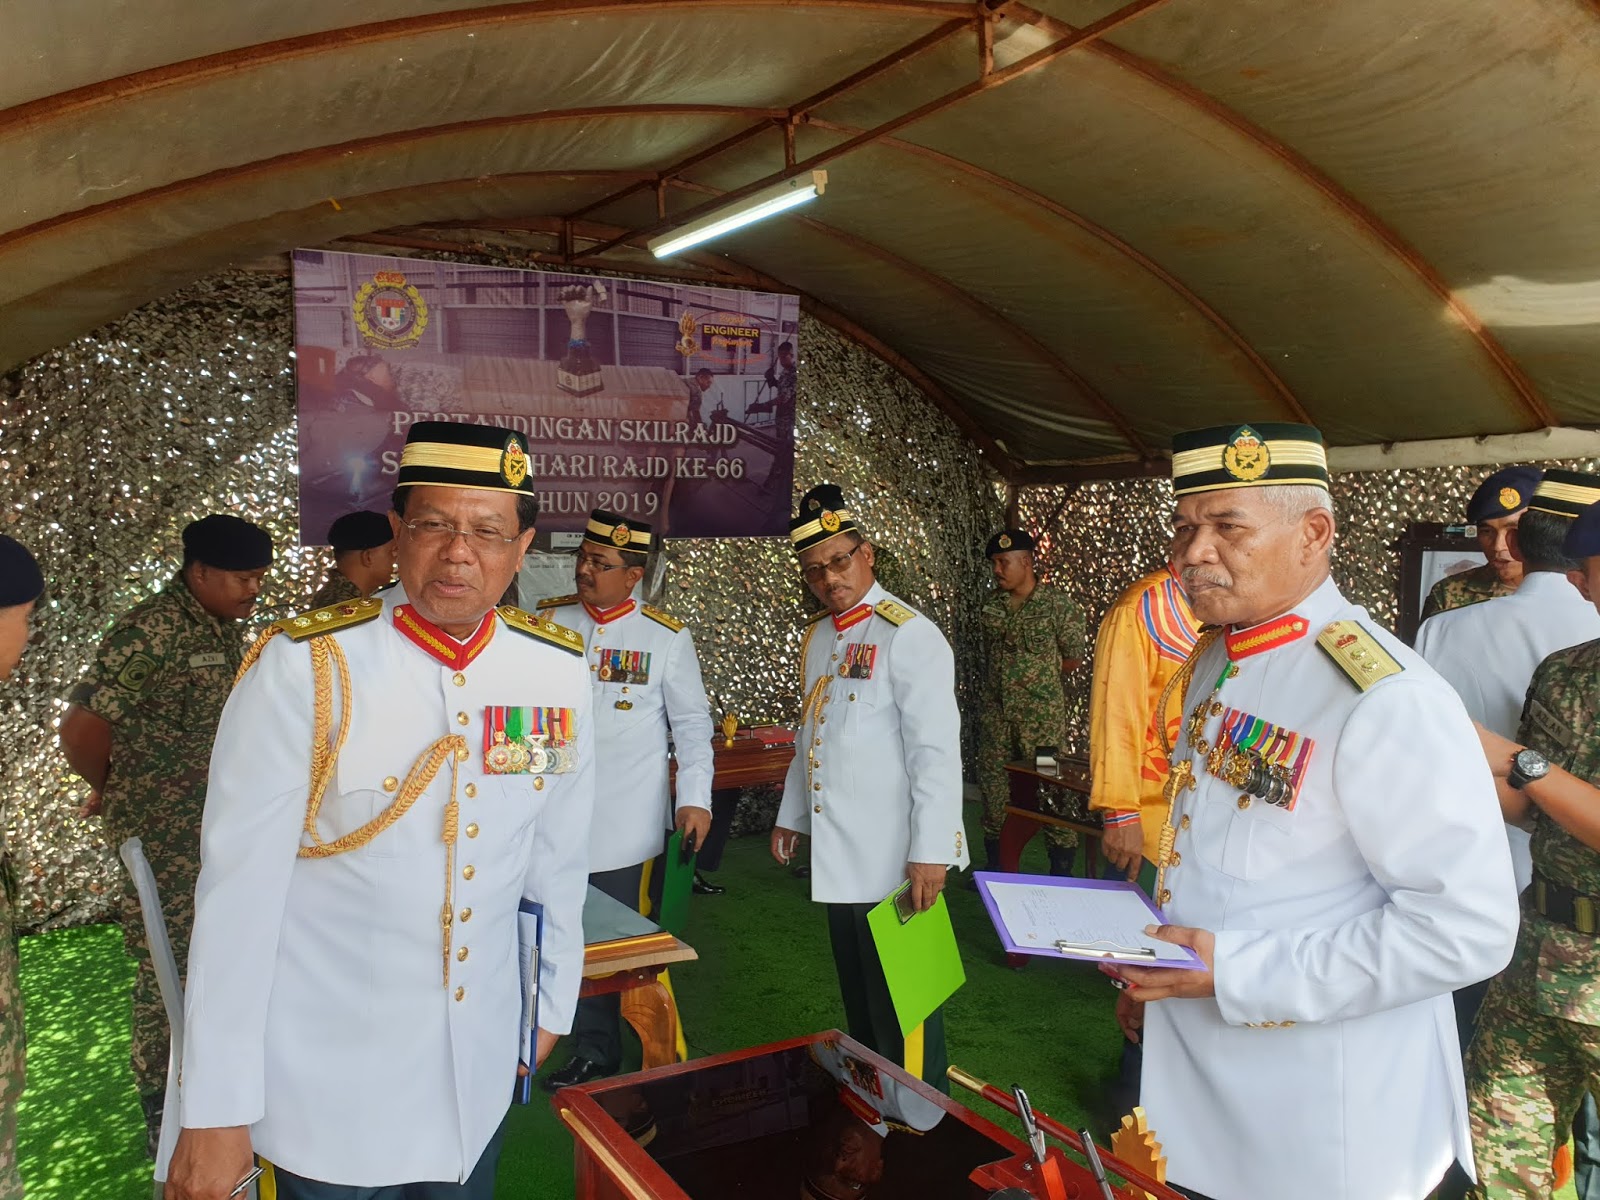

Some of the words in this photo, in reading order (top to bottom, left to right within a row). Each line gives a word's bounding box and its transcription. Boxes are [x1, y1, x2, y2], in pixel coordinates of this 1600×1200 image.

[703, 325, 759, 337] ENGINEER
[619, 418, 738, 445] SKILRAJD
[531, 453, 596, 478] HARI
[603, 454, 669, 479] RAJD
[675, 456, 745, 479] KE-66
[537, 490, 589, 513] HUN
[597, 491, 660, 516] 2019
